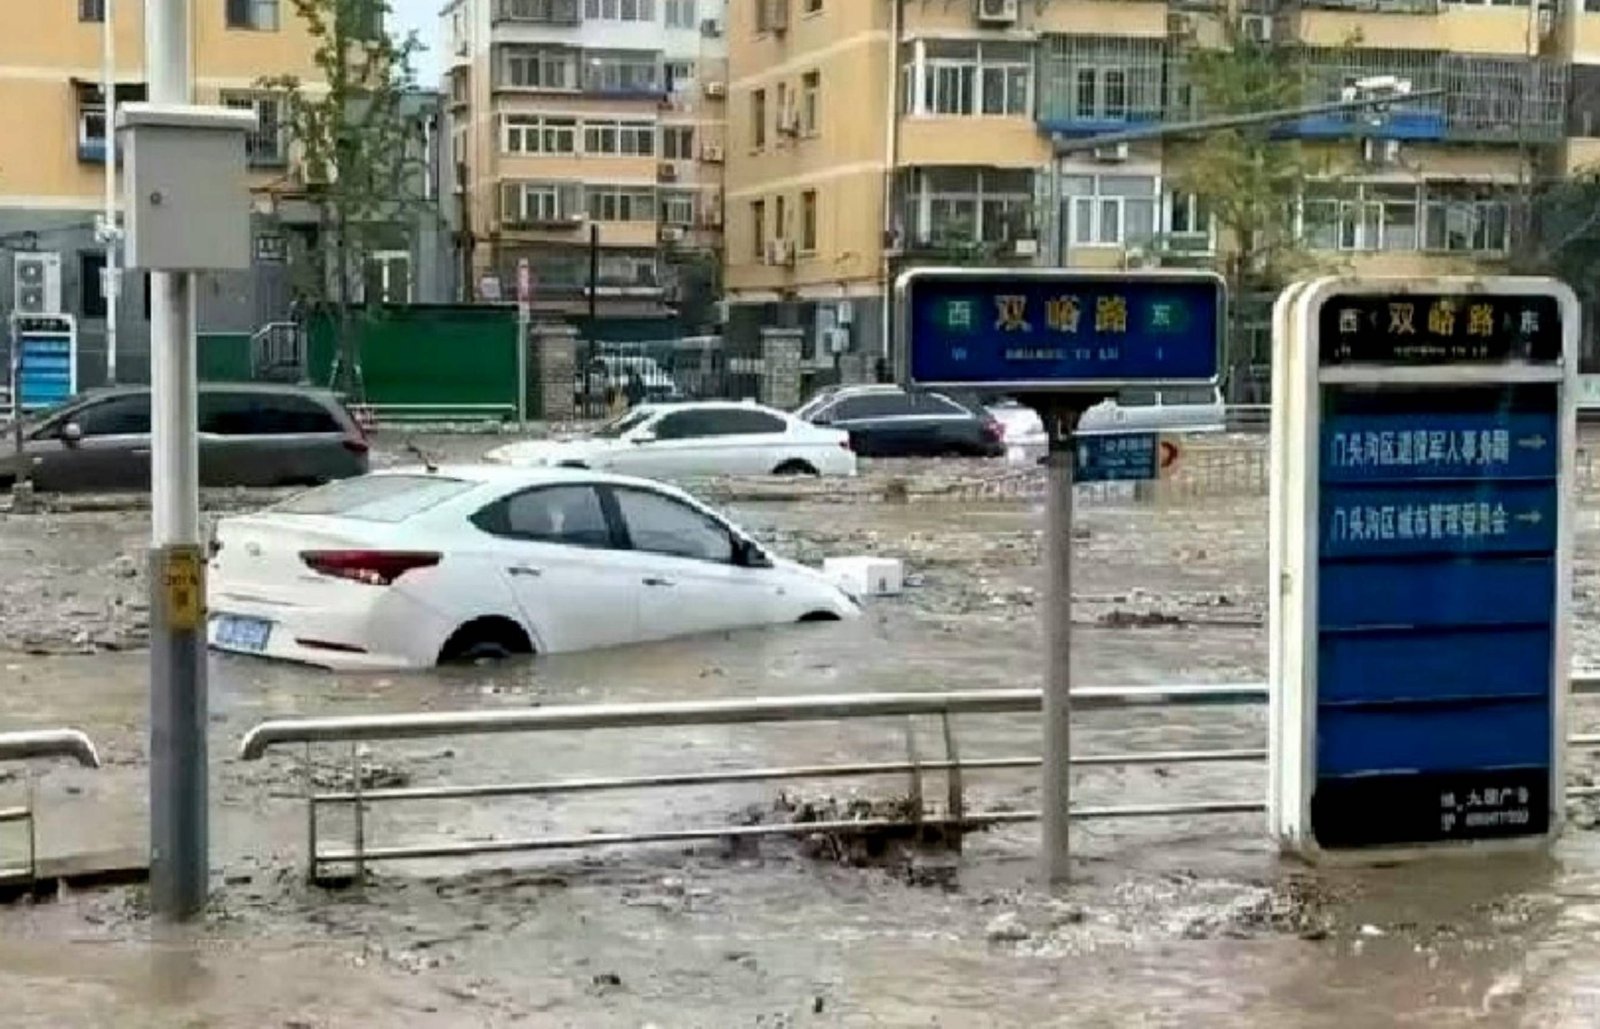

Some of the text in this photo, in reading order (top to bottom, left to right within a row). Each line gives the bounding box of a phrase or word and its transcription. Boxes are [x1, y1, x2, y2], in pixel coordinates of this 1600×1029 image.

[995, 295, 1127, 332] 双峪路
[1388, 300, 1494, 336] 双峪路
